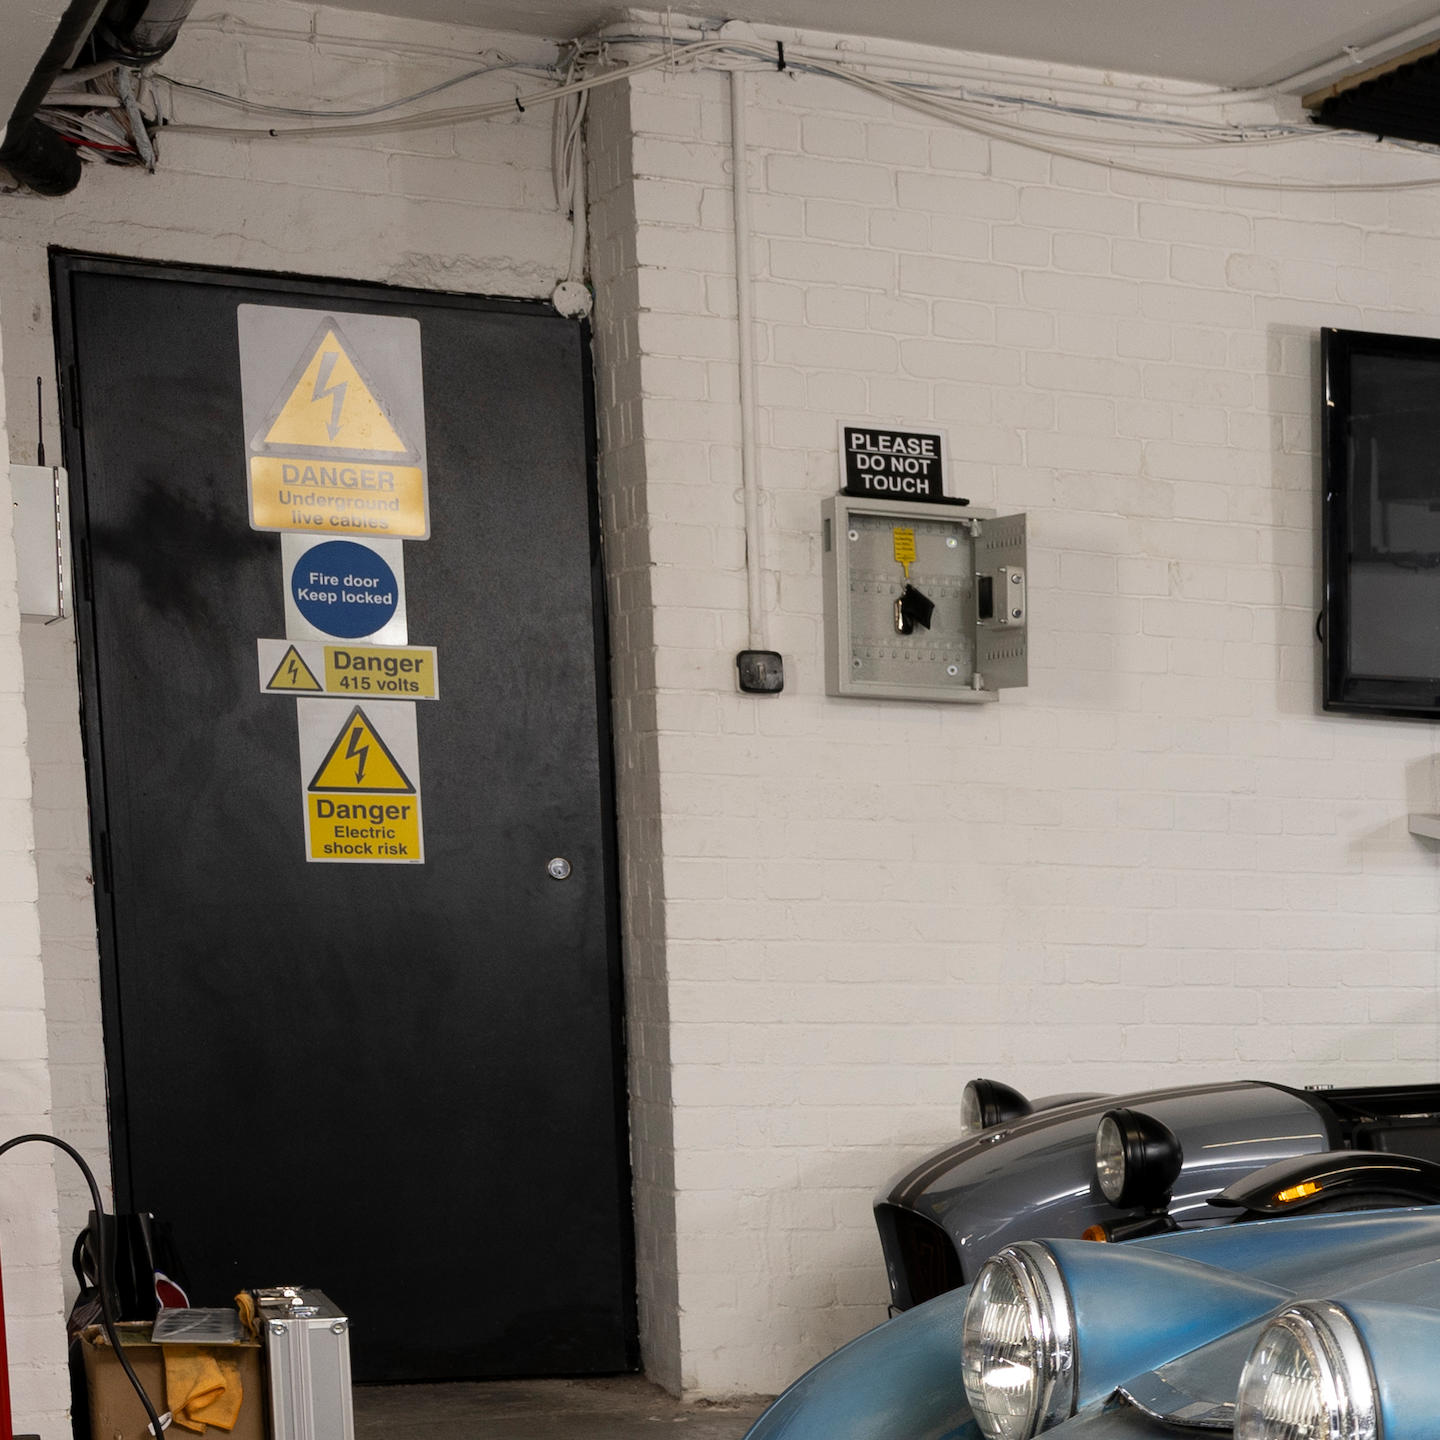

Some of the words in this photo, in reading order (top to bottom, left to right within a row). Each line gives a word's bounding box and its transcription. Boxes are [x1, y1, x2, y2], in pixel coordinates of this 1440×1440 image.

[851, 433, 934, 456] PLEASE
[857, 454, 885, 471] DO
[890, 457, 931, 474] NOT
[282, 464, 394, 490] DANGER
[861, 474, 930, 494] TOUCH
[279, 490, 400, 512] Underground
[292, 510, 323, 525] live
[329, 513, 389, 529] cables
[309, 572, 339, 586] Fire
[343, 574, 379, 588] door
[297, 588, 337, 604] Keep
[342, 590, 392, 605] locked
[333, 651, 424, 677] Danger
[340, 676, 371, 690] 415
[376, 677, 419, 692] volts
[317, 799, 411, 825] Danger
[334, 825, 396, 839] Electric
[323, 841, 373, 854] shock
[377, 842, 408, 855] risk
